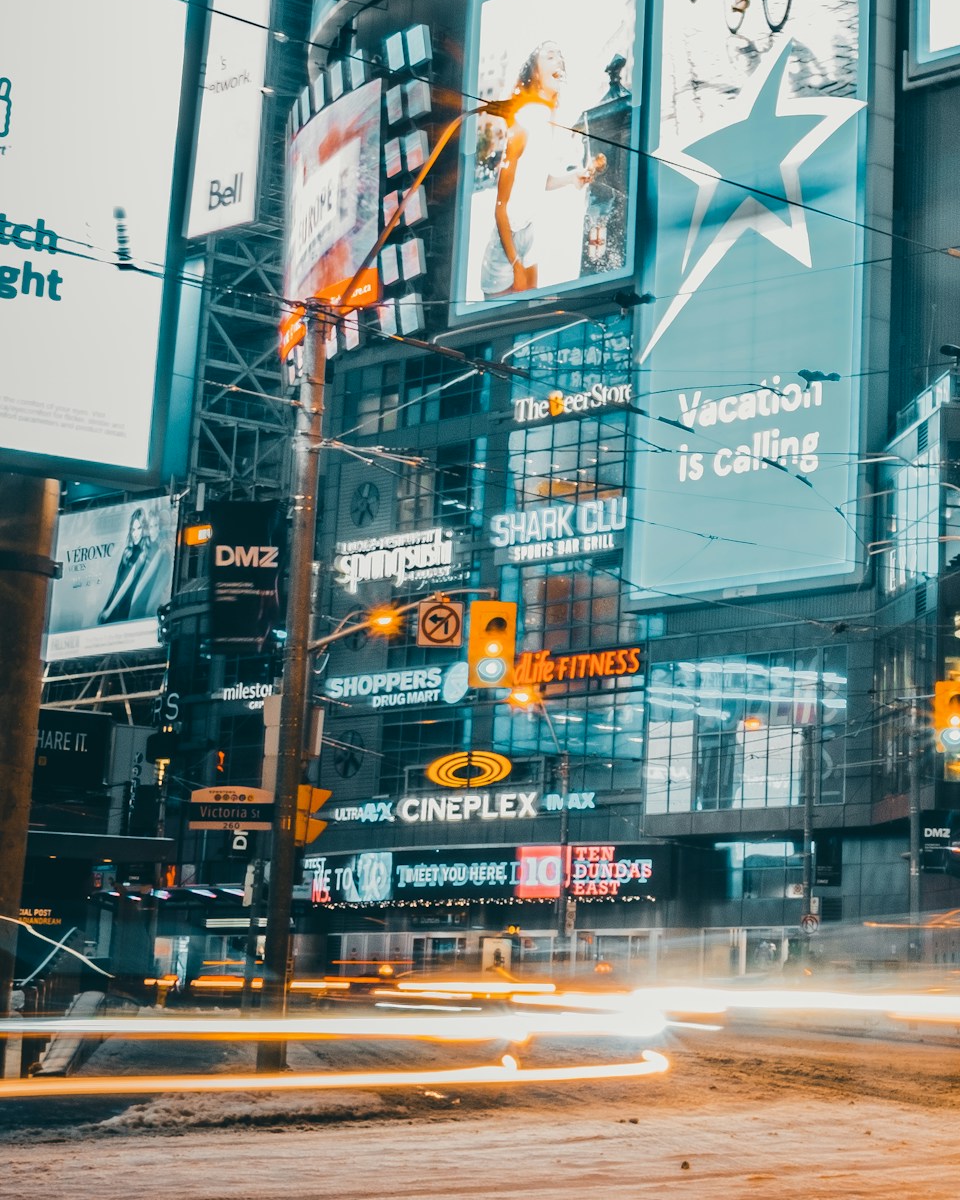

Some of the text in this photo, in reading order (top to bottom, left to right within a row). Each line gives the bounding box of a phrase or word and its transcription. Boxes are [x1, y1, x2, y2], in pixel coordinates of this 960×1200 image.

[209, 172, 243, 211] Bell
[515, 397, 550, 422] The
[549, 390, 592, 417] Beer
[678, 375, 823, 429] Vacation
[679, 428, 820, 483] is calling
[491, 504, 575, 548] SHARK
[66, 542, 115, 564] VÉRONIC
[215, 545, 279, 568] DMZ
[514, 541, 553, 561] SPORTS
[583, 533, 614, 551] GRILL
[514, 647, 641, 685] dLife FITNESS
[326, 667, 442, 699] SHOPPERS
[372, 688, 441, 708] DRUG MART
[36, 730, 88, 752] HARE IT.
[200, 806, 260, 818] Victoria St
[400, 791, 538, 823] CINEPLEX
[924, 828, 951, 838] DMZ
[575, 846, 616, 862] TEN
[405, 866, 439, 883] MEET
[442, 865, 466, 882] YOU
[469, 864, 507, 881] HERE.
[525, 855, 562, 887] 10
[572, 862, 653, 878] DUNDAS
[573, 880, 621, 896] EAST
[34, 908, 52, 916] POST
